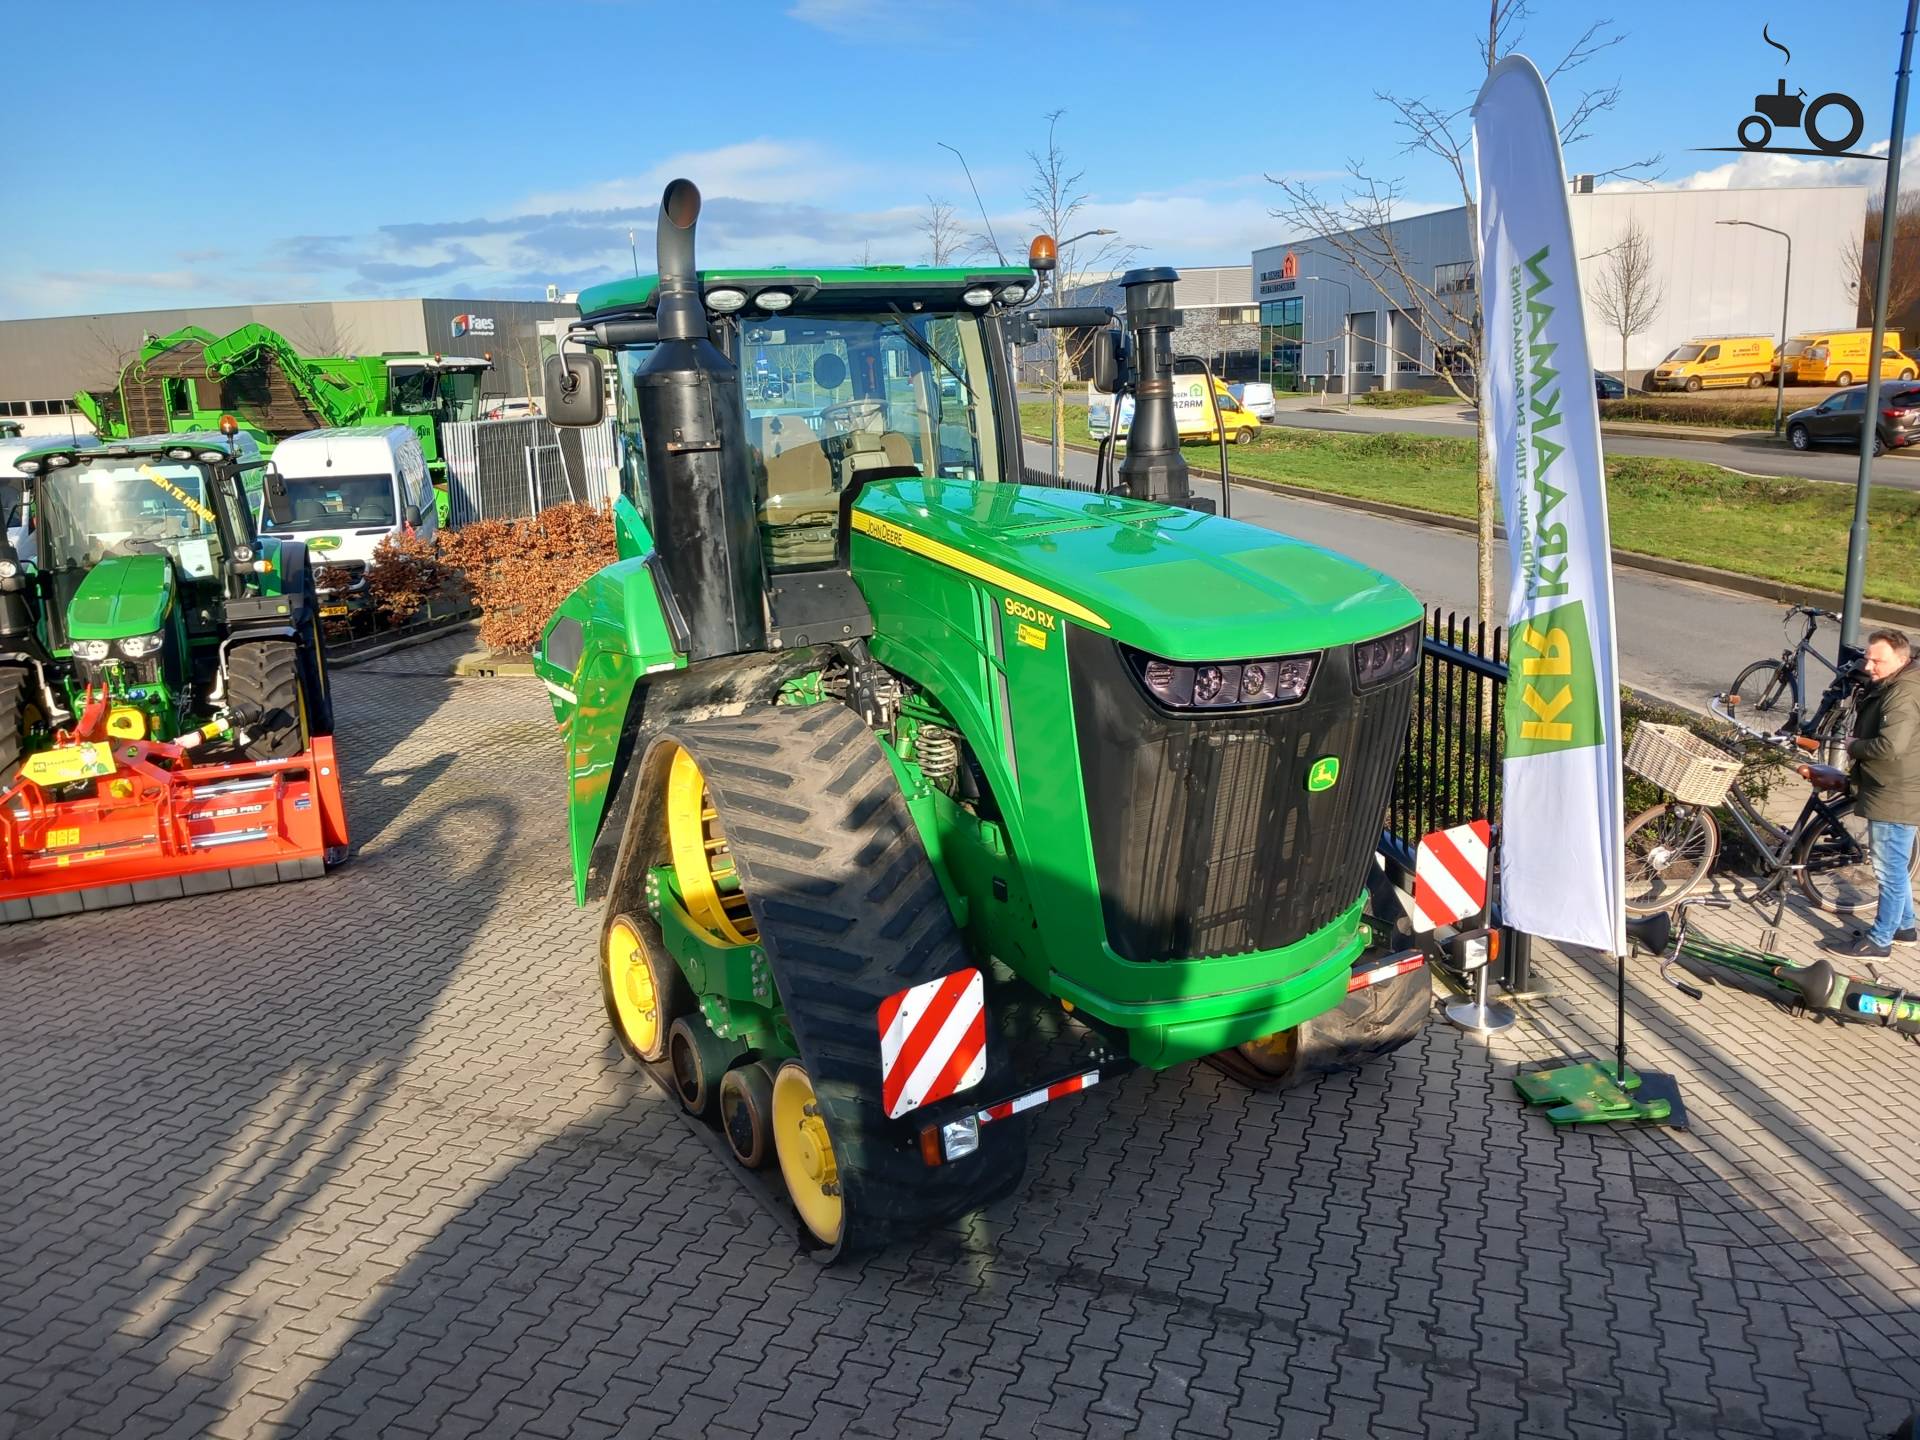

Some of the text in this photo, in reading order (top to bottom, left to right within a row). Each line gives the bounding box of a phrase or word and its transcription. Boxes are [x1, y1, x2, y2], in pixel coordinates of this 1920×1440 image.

[469, 314, 495, 330] Faes
[171, 487, 185, 500] TE
[184, 496, 215, 522] HUUR!
[866, 521, 903, 546] JOHN DEERE
[1004, 597, 1056, 631] 9620 RX
